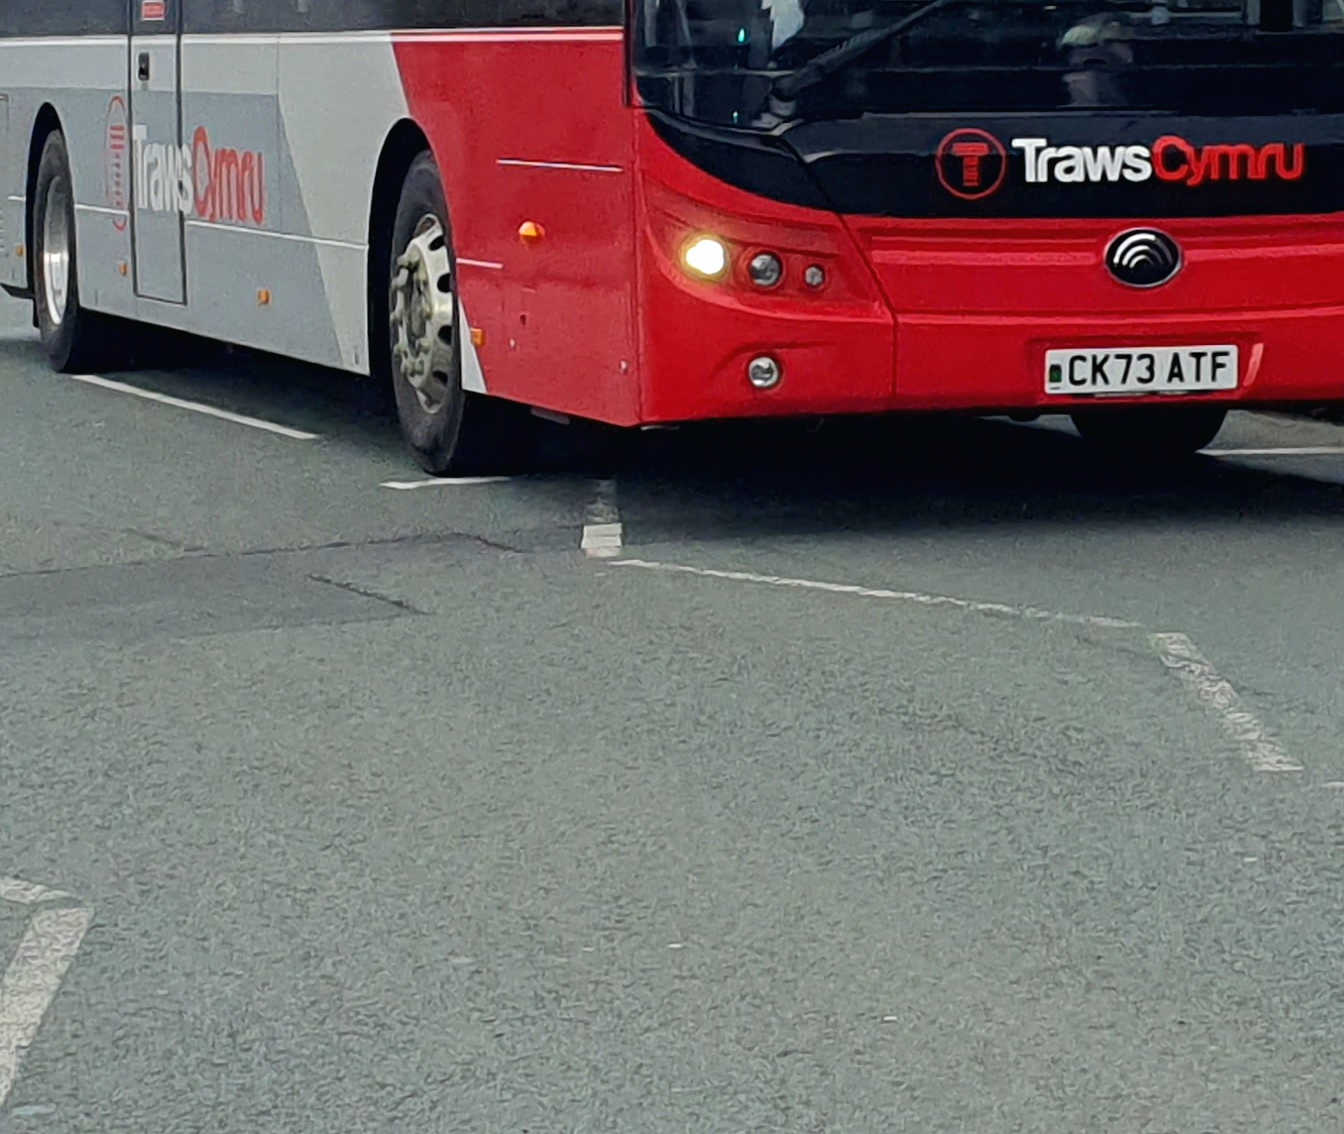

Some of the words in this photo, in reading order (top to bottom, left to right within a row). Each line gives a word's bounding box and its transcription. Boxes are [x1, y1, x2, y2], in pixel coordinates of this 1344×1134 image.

[1011, 135, 1306, 186] TrawsCymru
[1068, 353, 1156, 387] CK73
[1166, 351, 1231, 384] ATF
